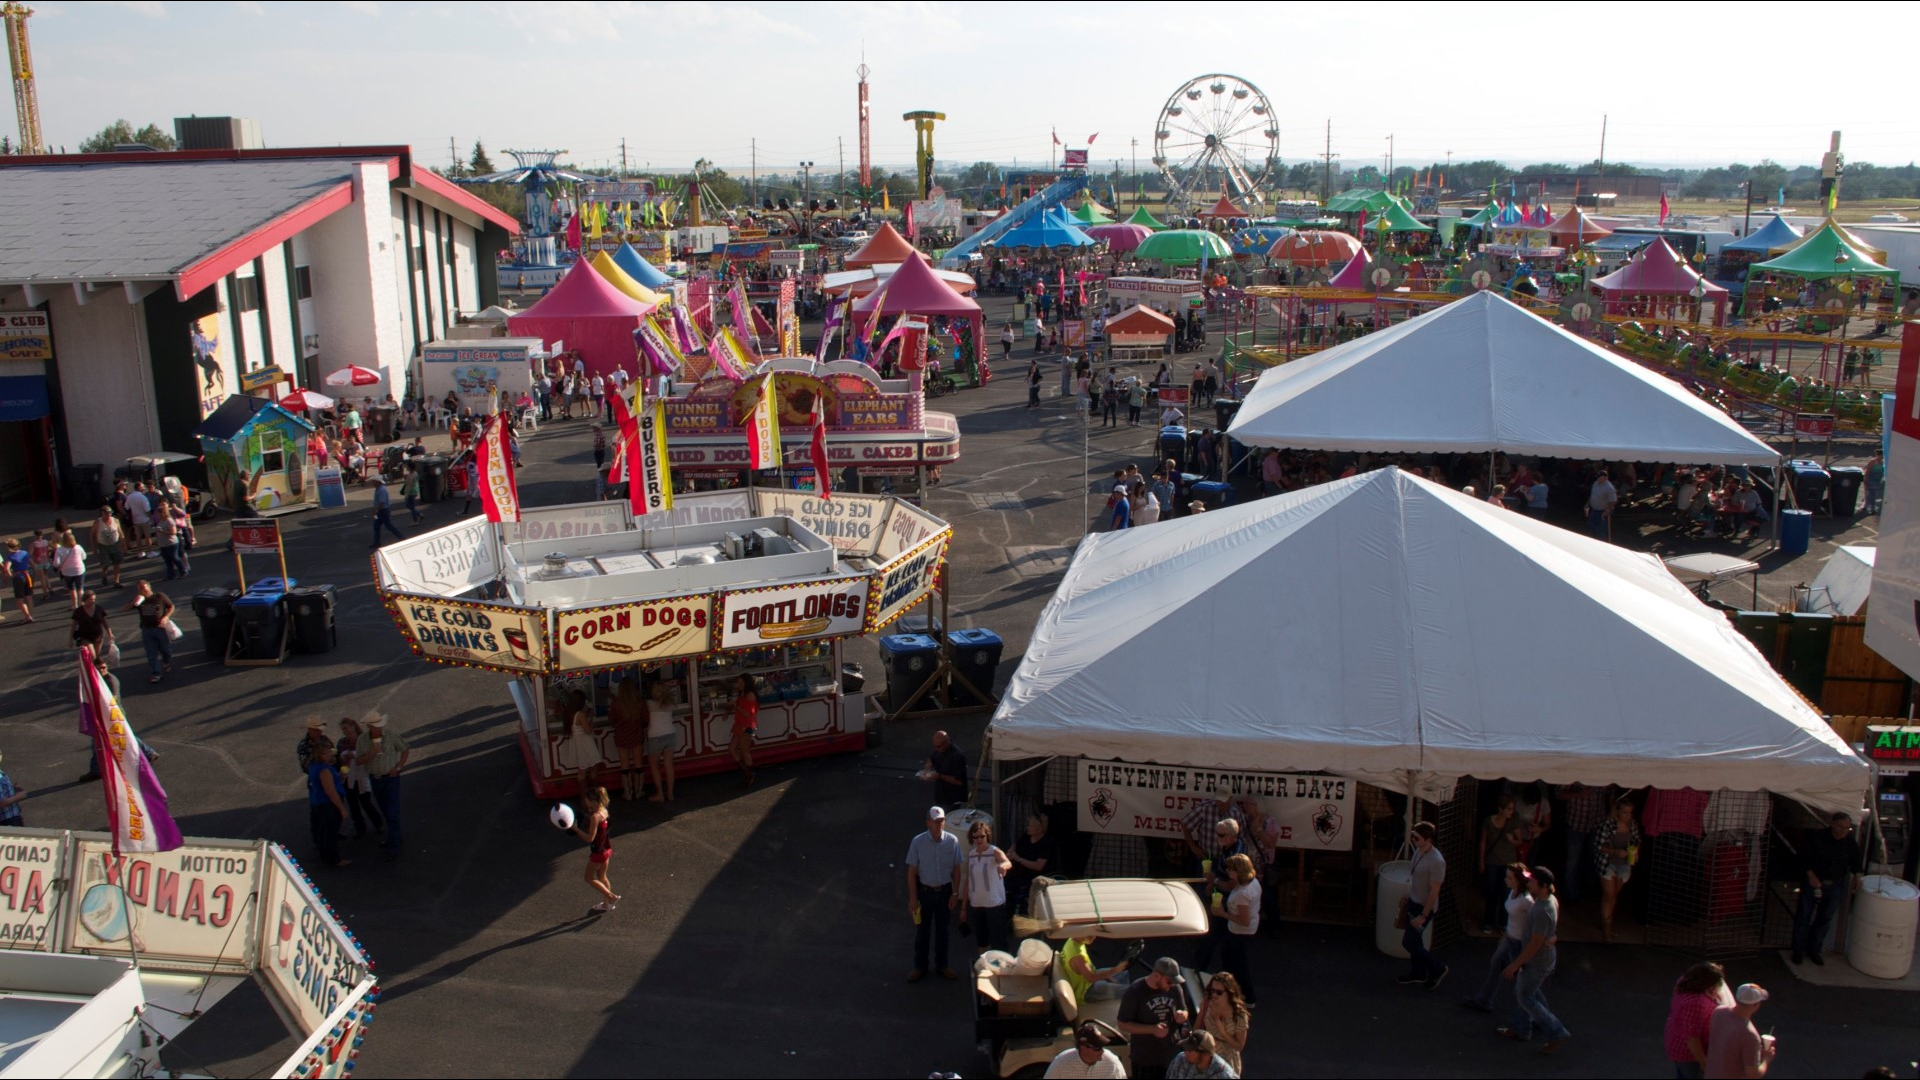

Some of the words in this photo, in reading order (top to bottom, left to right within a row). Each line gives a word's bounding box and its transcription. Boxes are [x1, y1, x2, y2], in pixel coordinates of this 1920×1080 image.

[1109, 281, 1138, 290] TICKETS
[1150, 284, 1182, 293] TICKETS
[11, 316, 45, 327] CLUB
[10, 350, 43, 358] CAFE
[458, 352, 470, 360] ICE
[472, 351, 499, 360] CREAM
[202, 395, 224, 412] AFE
[665, 403, 723, 416] FUNNEL
[844, 400, 905, 413] ELEPHANT
[671, 416, 718, 428] CAKES
[852, 413, 898, 425] EARS
[760, 418, 769, 462] DOGS
[668, 450, 705, 463] RIED
[713, 450, 752, 463] DOU
[794, 448, 856, 461] FUNEL
[862, 446, 914, 459] CAKES
[643, 416, 661, 507] BURGERS
[492, 475, 513, 515] DOGS
[410, 604, 439, 623] ICE
[442, 608, 492, 630] COLD
[731, 591, 861, 633] FOOTLONGS
[564, 611, 631, 645] CORN
[642, 607, 706, 629] DOGS
[416, 623, 499, 652] DRINKS
[1875, 731, 1920, 748] ATM
[1873, 749, 1902, 758] Bank
[1088, 764, 1187, 790] CHEYENNE
[1194, 772, 1288, 797] FRONTIER
[1296, 779, 1346, 800] DAYS
